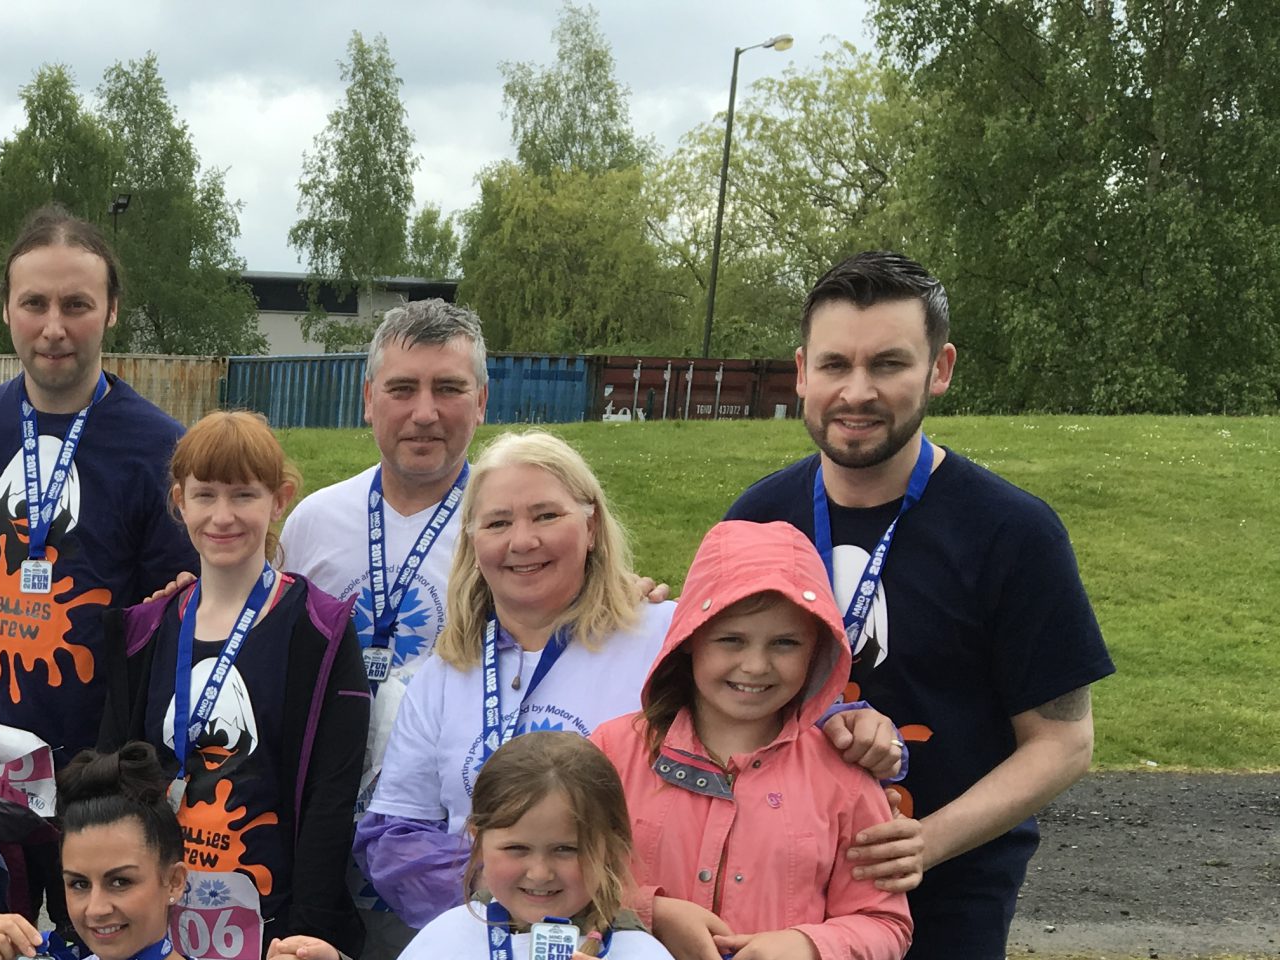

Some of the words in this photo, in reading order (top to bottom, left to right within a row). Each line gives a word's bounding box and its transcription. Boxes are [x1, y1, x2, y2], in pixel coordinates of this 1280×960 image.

[60, 441, 75, 467] 2017
[69, 418, 84, 440] FUN
[25, 454, 37, 479] 2017
[28, 481, 38, 503] FUN
[29, 505, 39, 529] RUN
[416, 529, 435, 553] 2017
[432, 509, 450, 530] FUN
[449, 486, 464, 509] RUN
[371, 543, 382, 567] 2017
[31, 574, 49, 582] FUN
[31, 582, 49, 590] RUN
[372, 569, 384, 592] FUN
[852, 595, 866, 618] MND
[868, 543, 886, 576] 2017
[427, 585, 445, 623] Neurone
[196, 698, 210, 718] MND
[212, 656, 231, 684] 2017
[225, 632, 243, 656] FUN
[237, 607, 256, 632] RUN
[370, 661, 389, 669] FUN
[485, 643, 495, 667] FUN
[367, 669, 386, 678] RUN
[486, 667, 497, 693] 2017
[531, 704, 544, 714] by
[544, 704, 574, 722] Motor
[183, 847, 219, 868] rew
[548, 943, 574, 955] FUN
